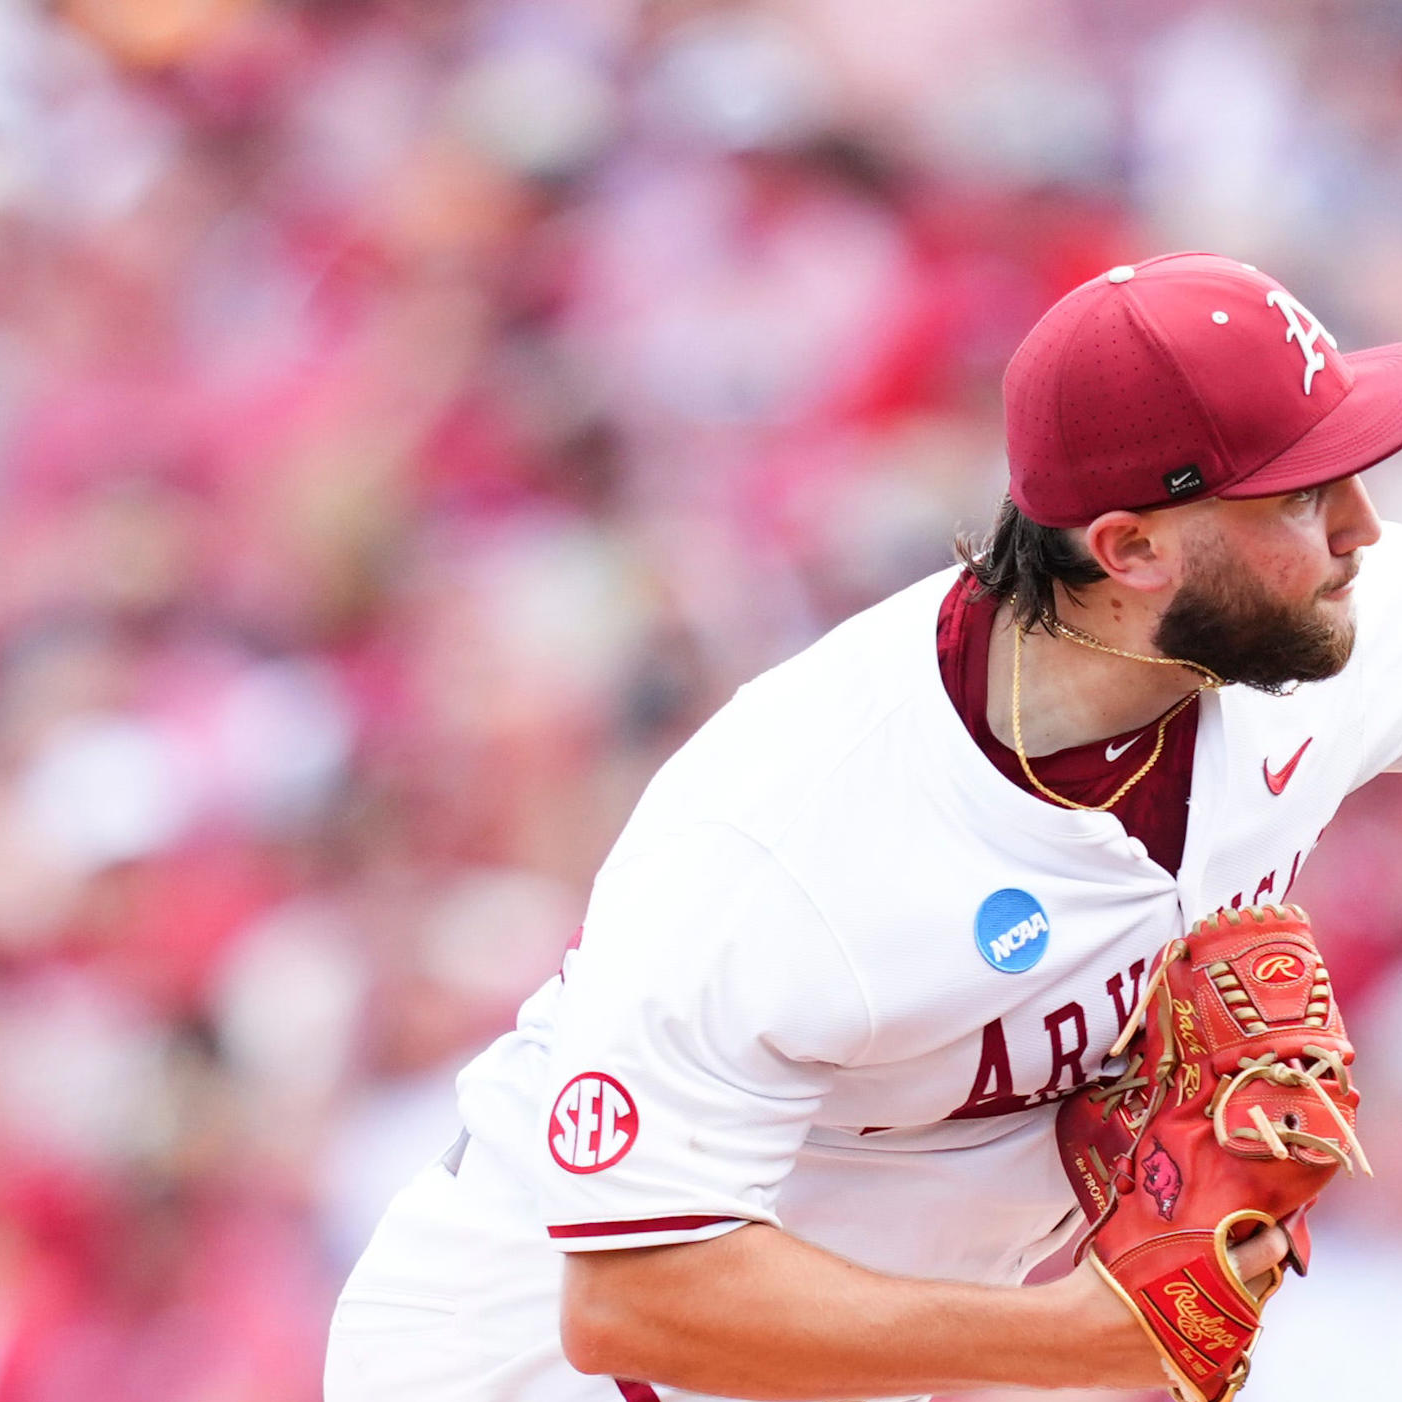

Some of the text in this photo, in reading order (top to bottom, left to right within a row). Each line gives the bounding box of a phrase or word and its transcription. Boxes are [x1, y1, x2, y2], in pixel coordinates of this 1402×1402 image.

[1266, 290, 1337, 395] A
[989, 911, 1048, 962] NCAA
[1255, 956, 1299, 980] R
[552, 1077, 631, 1167] SEC
[1163, 1281, 1238, 1351] Rawlings
